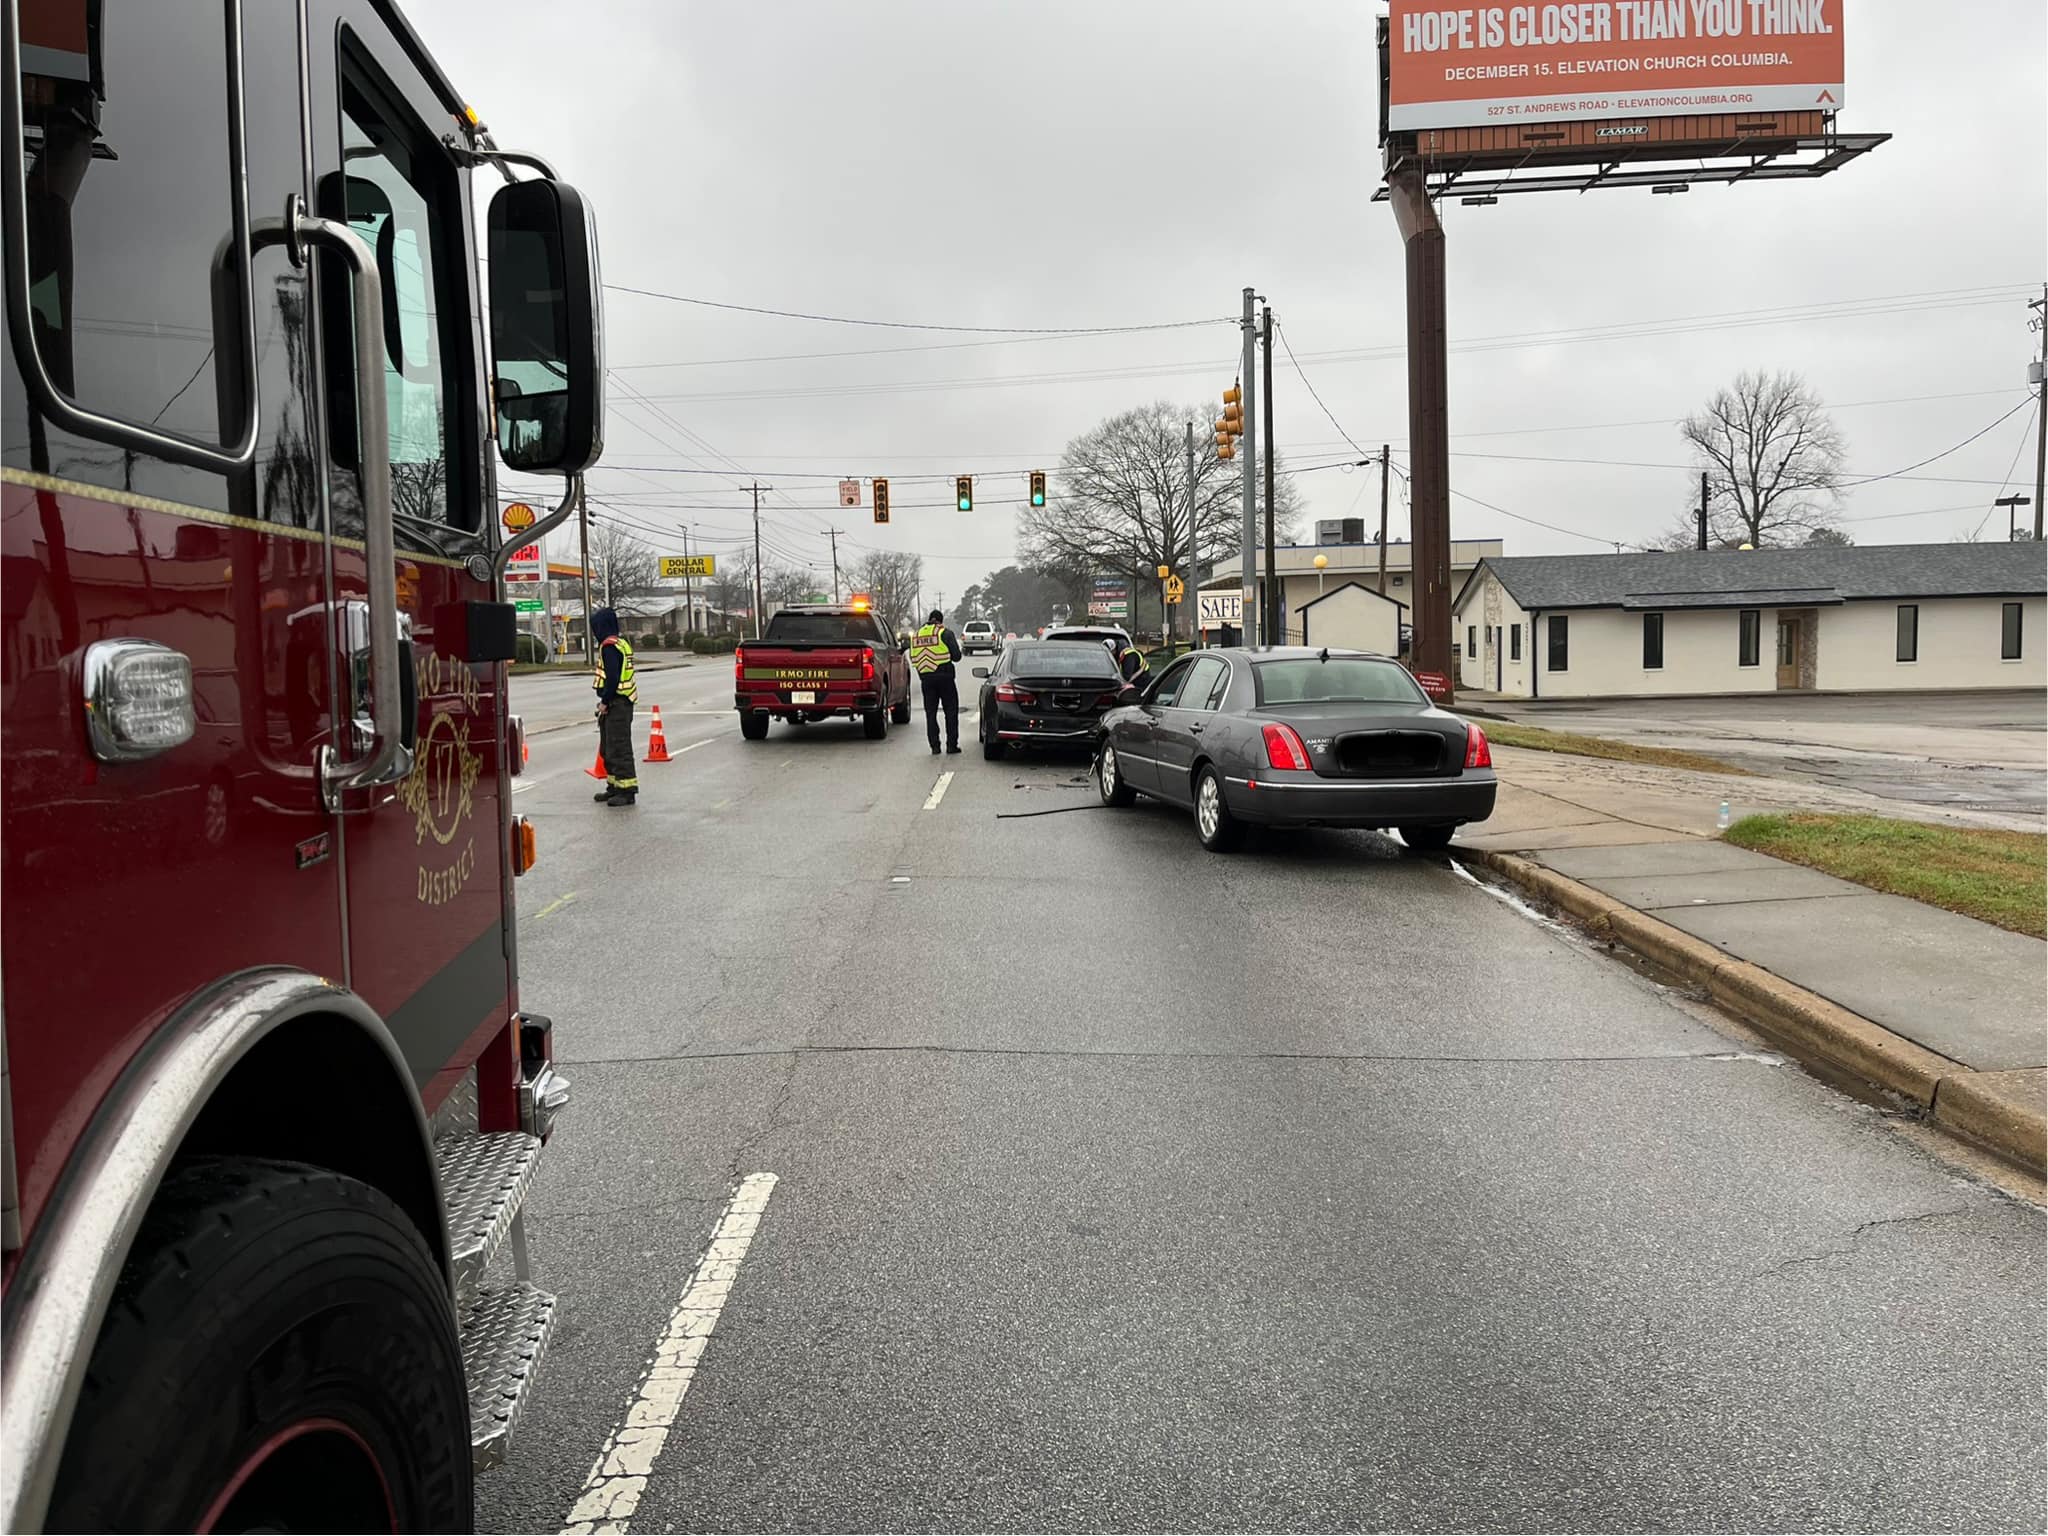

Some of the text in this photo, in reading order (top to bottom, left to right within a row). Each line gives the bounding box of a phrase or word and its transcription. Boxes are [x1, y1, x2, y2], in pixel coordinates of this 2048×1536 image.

[1402, 0, 1833, 53] HOPE IS CLOSER THAN YOU THINK.
[1445, 52, 1793, 81] DECEMBER 15. ELEVATION CHURCH COLUMBIA.
[1487, 94, 1753, 116] 527 ST. ANDREWS ROAD ELEVATIONCOLUMBIA.ORG
[1599, 126, 1642, 137] LAMAR
[668, 558, 704, 567] DOLLAR
[1201, 597, 1241, 618] SAFE
[449, 653, 481, 717] FIRE
[775, 670, 830, 679] IRMO FIRE
[779, 681, 793, 689] ISO
[796, 681, 820, 689] CLASS
[436, 743, 454, 818] 17
[417, 838, 475, 905] DISTRICT
